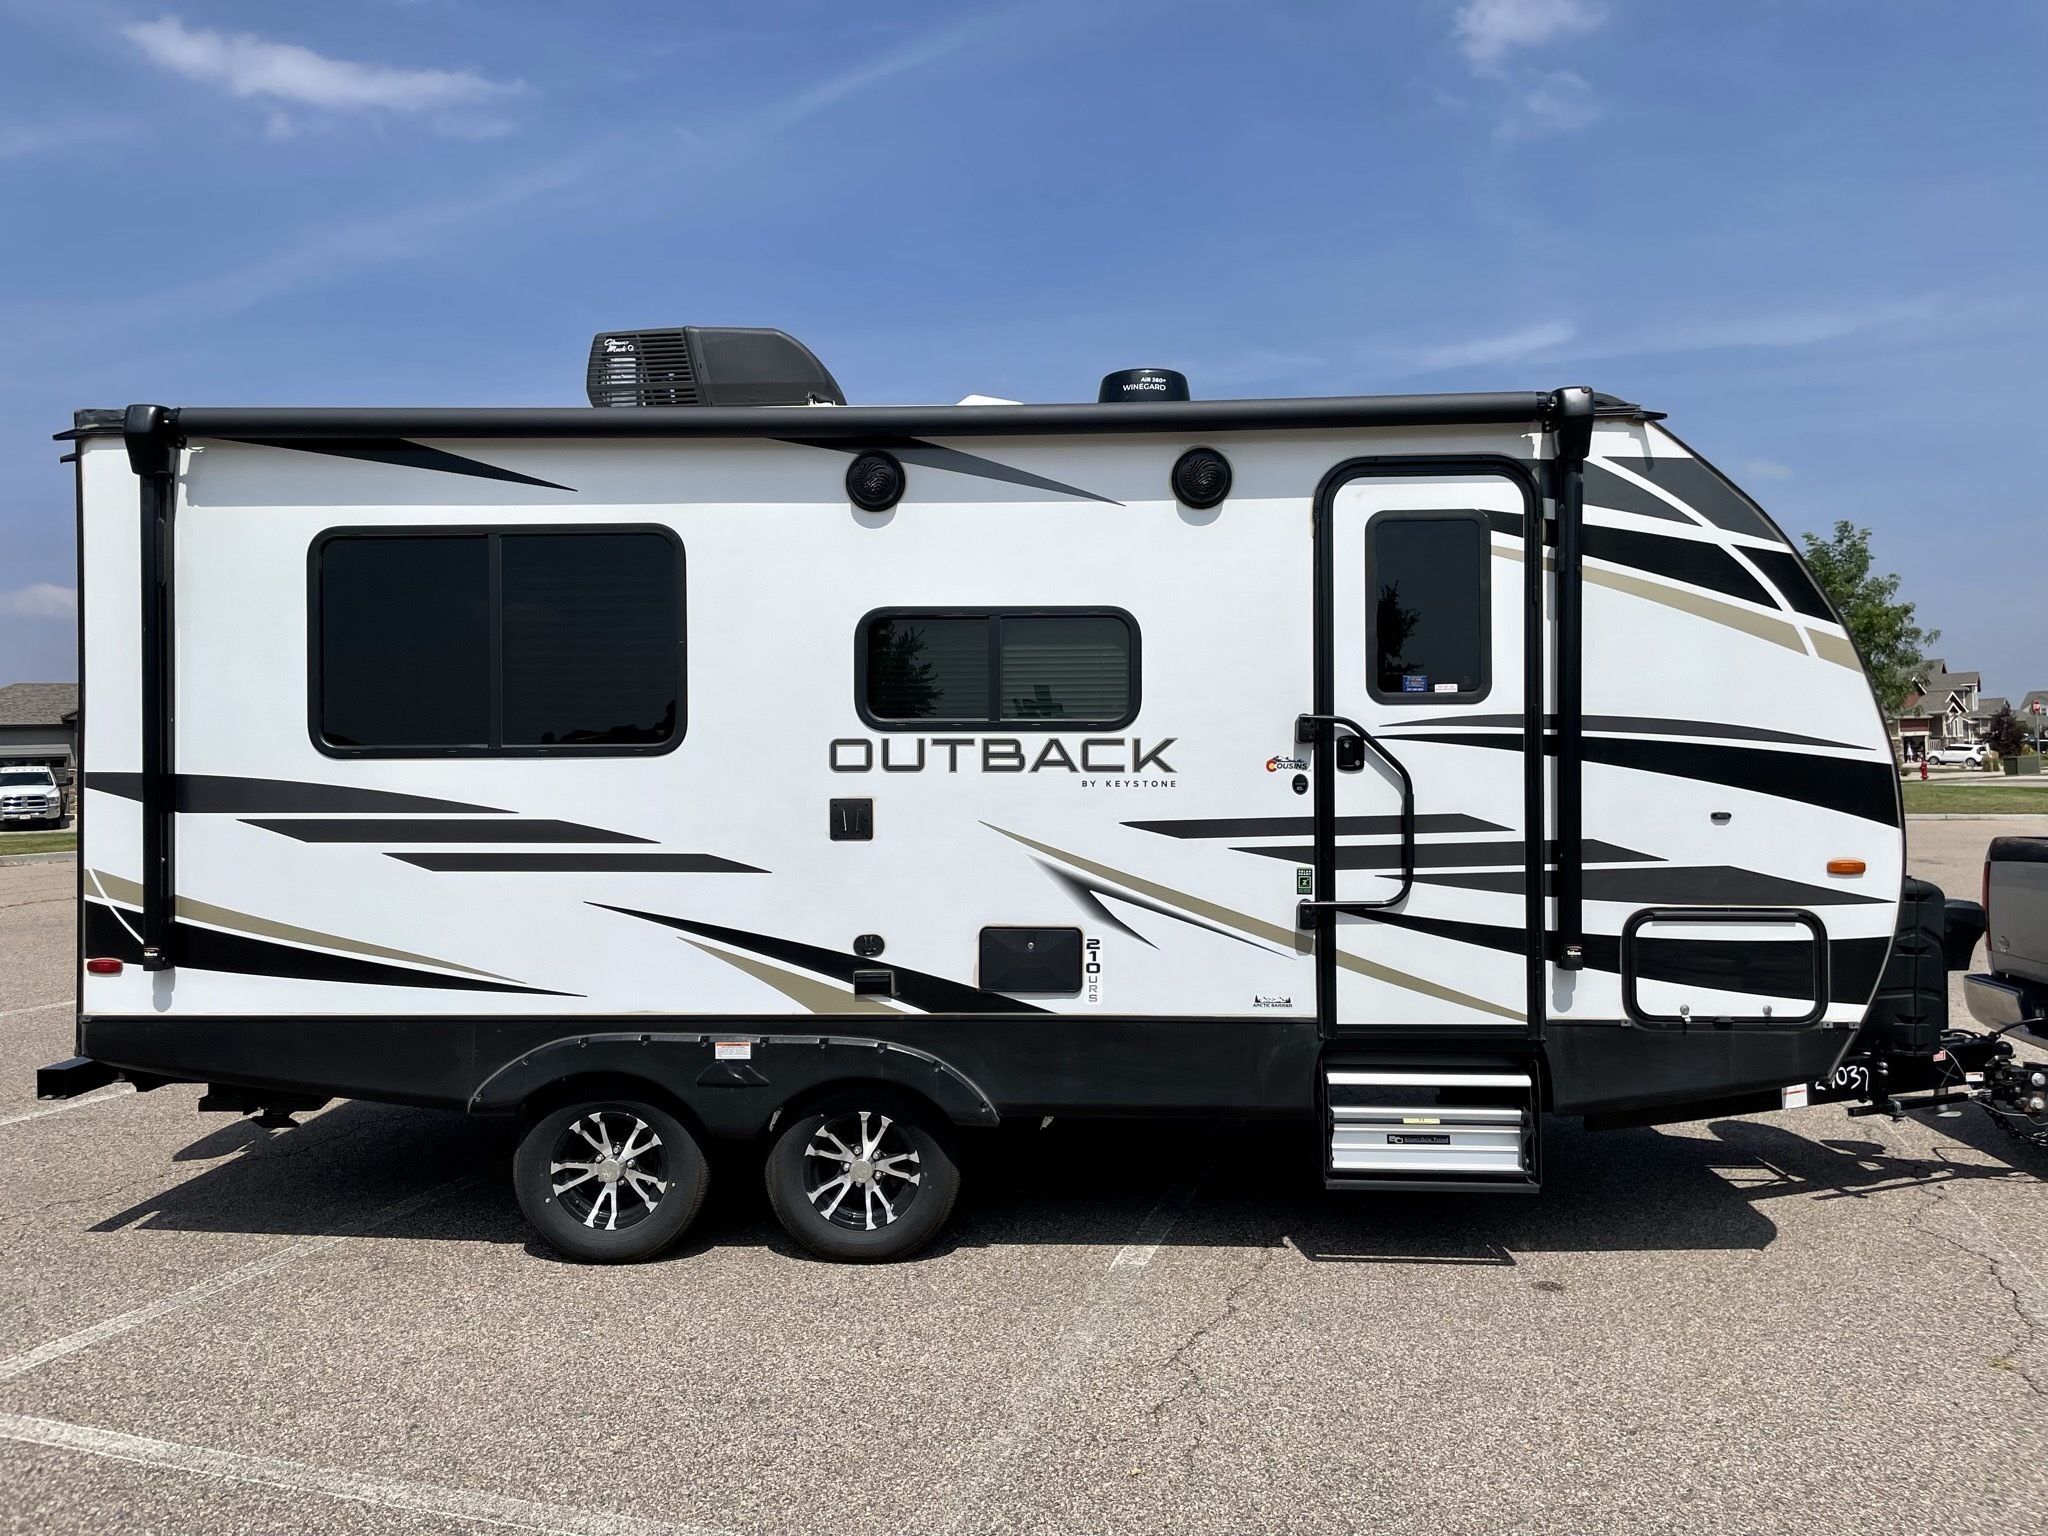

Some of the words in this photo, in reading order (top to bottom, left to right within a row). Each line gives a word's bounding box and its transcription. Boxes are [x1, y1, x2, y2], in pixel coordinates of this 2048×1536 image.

[1122, 383, 1167, 391] WINEGARD
[829, 737, 1179, 774] OUTBACK
[1265, 759, 1308, 773] COUSINS
[1081, 780, 1097, 788] BY
[1105, 780, 1178, 788] KEYSTONE
